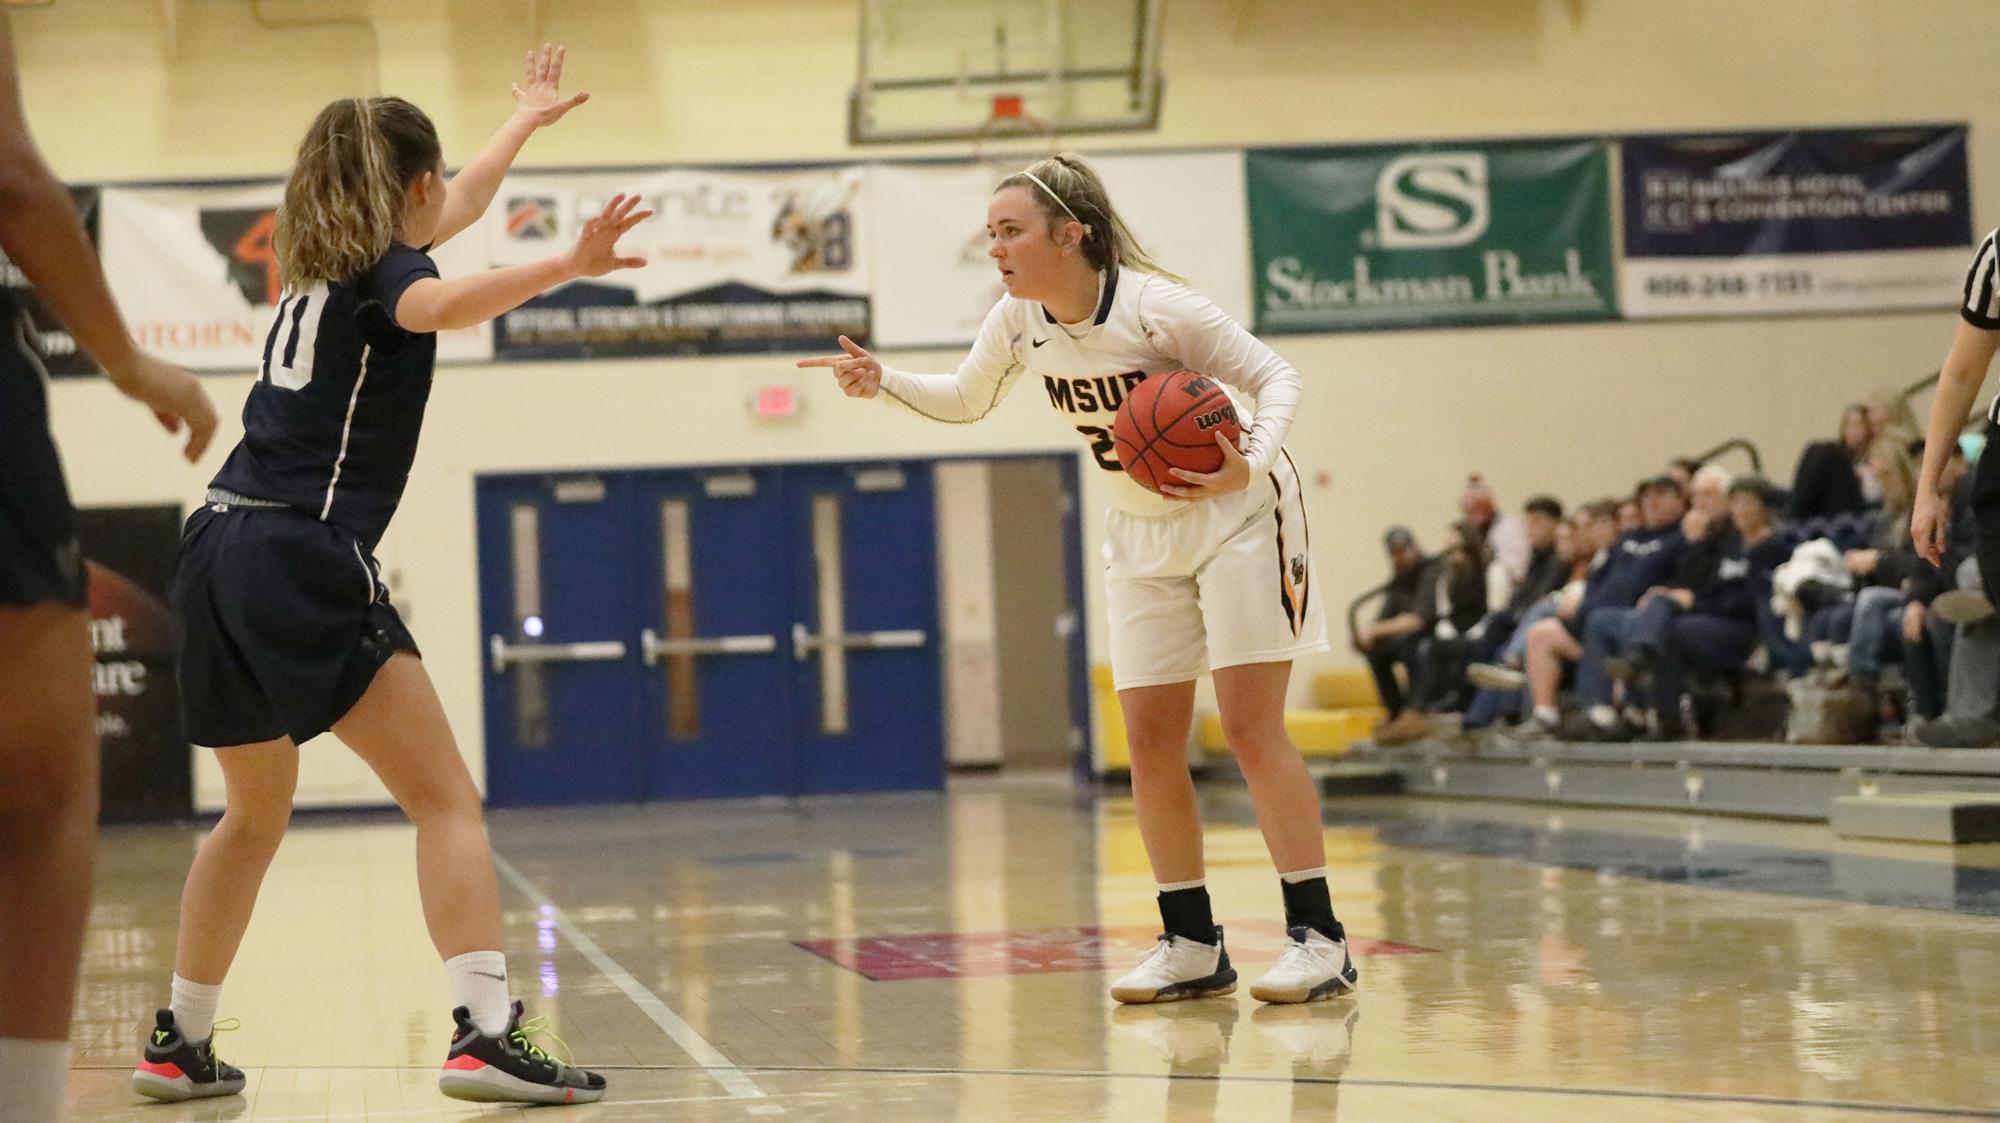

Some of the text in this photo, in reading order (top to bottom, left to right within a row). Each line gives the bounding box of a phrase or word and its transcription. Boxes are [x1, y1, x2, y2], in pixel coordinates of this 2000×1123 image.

[1264, 249, 1597, 309] Stockman Bank
[1076, 424, 1125, 471] 2
